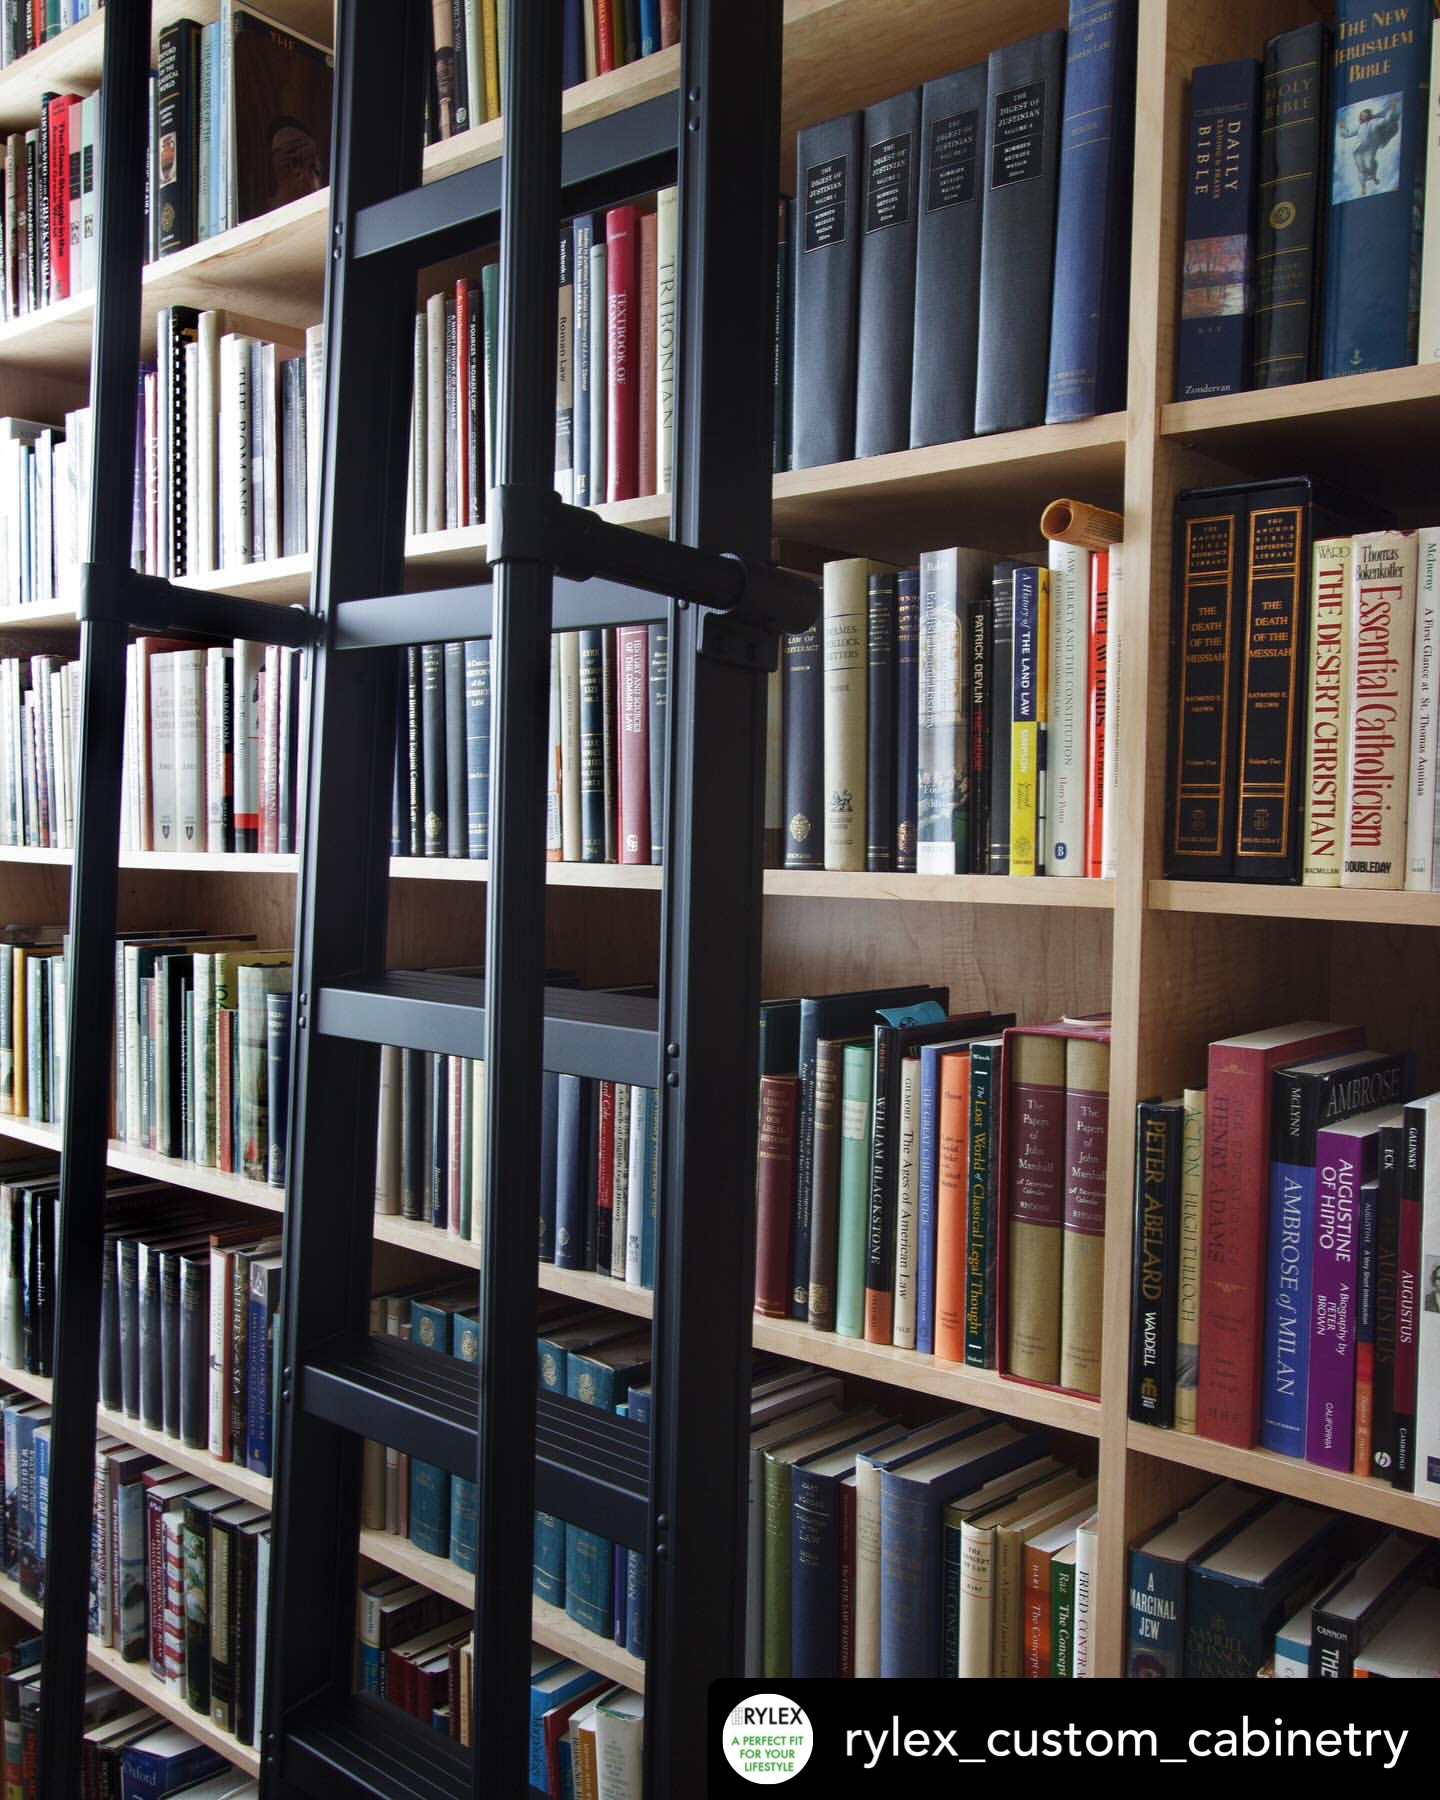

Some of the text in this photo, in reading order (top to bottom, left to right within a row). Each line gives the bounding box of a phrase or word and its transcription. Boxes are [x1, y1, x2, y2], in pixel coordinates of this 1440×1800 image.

[1340, 7, 1409, 41] THE NEW
[1333, 29, 1415, 68] JERUSALEM
[1348, 60, 1391, 83] BIBLE
[1265, 77, 1314, 102] HOLY
[998, 110, 1041, 128] JUSTINIAN
[1264, 95, 1313, 120] BIBLE
[1194, 124, 1212, 196] BIBLE
[1224, 121, 1241, 191] DAILY
[559, 316, 568, 382] Roman Law
[615, 292, 626, 385] TEXTBOOK OF
[1184, 383, 1232, 395] Zondervan
[1361, 545, 1399, 563] Thomas
[1021, 573, 1033, 581] A
[1021, 584, 1033, 617] History
[1198, 606, 1217, 616] THE
[1261, 600, 1284, 611] THE
[1424, 608, 1434, 616] A
[1191, 621, 1222, 632] DEATH
[1253, 631, 1289, 643] OF THE
[1254, 615, 1289, 627] DEATH
[1424, 619, 1433, 643] First
[974, 614, 985, 704] PATRICK DEVLIN
[1021, 631, 1031, 654] THE
[1095, 591, 1108, 727] THE LAW LORDS
[1206, 637, 1223, 647] THE
[1248, 647, 1295, 660] MESSIAH
[1020, 657, 1031, 689] LAND
[1422, 645, 1433, 680] Glance
[624, 673, 633, 711] COMMON
[1020, 692, 1030, 716] LAW
[624, 713, 633, 732] LAW
[1063, 682, 1073, 766] CONSTITUTION
[1310, 563, 1345, 857] THE DESERT CHRISTIAN
[1349, 584, 1404, 848] Essential Catholicism
[1418, 715, 1430, 754] Thomas
[1416, 757, 1429, 797] Aquinas
[1344, 860, 1392, 874] DOUBLEDAY
[976, 1085, 985, 1099] The
[1326, 1068, 1401, 1118] AMBROSE
[975, 1099, 988, 1127] Lost
[1290, 1087, 1302, 1137] McLYNN
[903, 1131, 914, 1154] The
[973, 1132, 987, 1170] World
[1184, 1108, 1202, 1178] ACTON
[1383, 1148, 1395, 1169] ECK
[1406, 1126, 1418, 1171] GALINSKY
[871, 1096, 887, 1265] WILLIAM BLACKSTONE
[902, 1159, 914, 1188] Ages
[1207, 1095, 1230, 1265] HENRY ADAMS
[900, 1192, 913, 1205] of
[971, 1184, 986, 1239] Classical
[1141, 1119, 1168, 1301] PETER ABELARD
[1318, 1165, 1337, 1249] OF HIPPO
[1335, 1157, 1354, 1263] AUGUSTINE
[899, 1209, 912, 1268] American
[1279, 1176, 1302, 1291] AMBROSE
[968, 1243, 985, 1277] Legal
[1180, 1192, 1199, 1323] HUGH TULLOCH
[898, 1273, 911, 1301] Law
[1277, 1293, 1297, 1314] of
[966, 1280, 984, 1335] Thought
[1316, 1295, 1327, 1336] BROWN
[1327, 1301, 1337, 1331] PETER
[1335, 1282, 1350, 1356] A Biography by
[1400, 1269, 1415, 1344] AUGUSTUS
[1143, 1311, 1158, 1368] WADDELL
[1275, 1315, 1298, 1397] MILAN
[1323, 1401, 1334, 1450] CALIFORNIA
[1079, 1570, 1089, 1614] FRIED
[1147, 1571, 1156, 1592] A
[1032, 1604, 1042, 1625] The
[1129, 1590, 1177, 1620] MARGINAL
[1057, 1572, 1071, 1677] Raz The Concept
[1138, 1618, 1161, 1641] JEW
[1031, 1626, 1042, 1669] Concept
